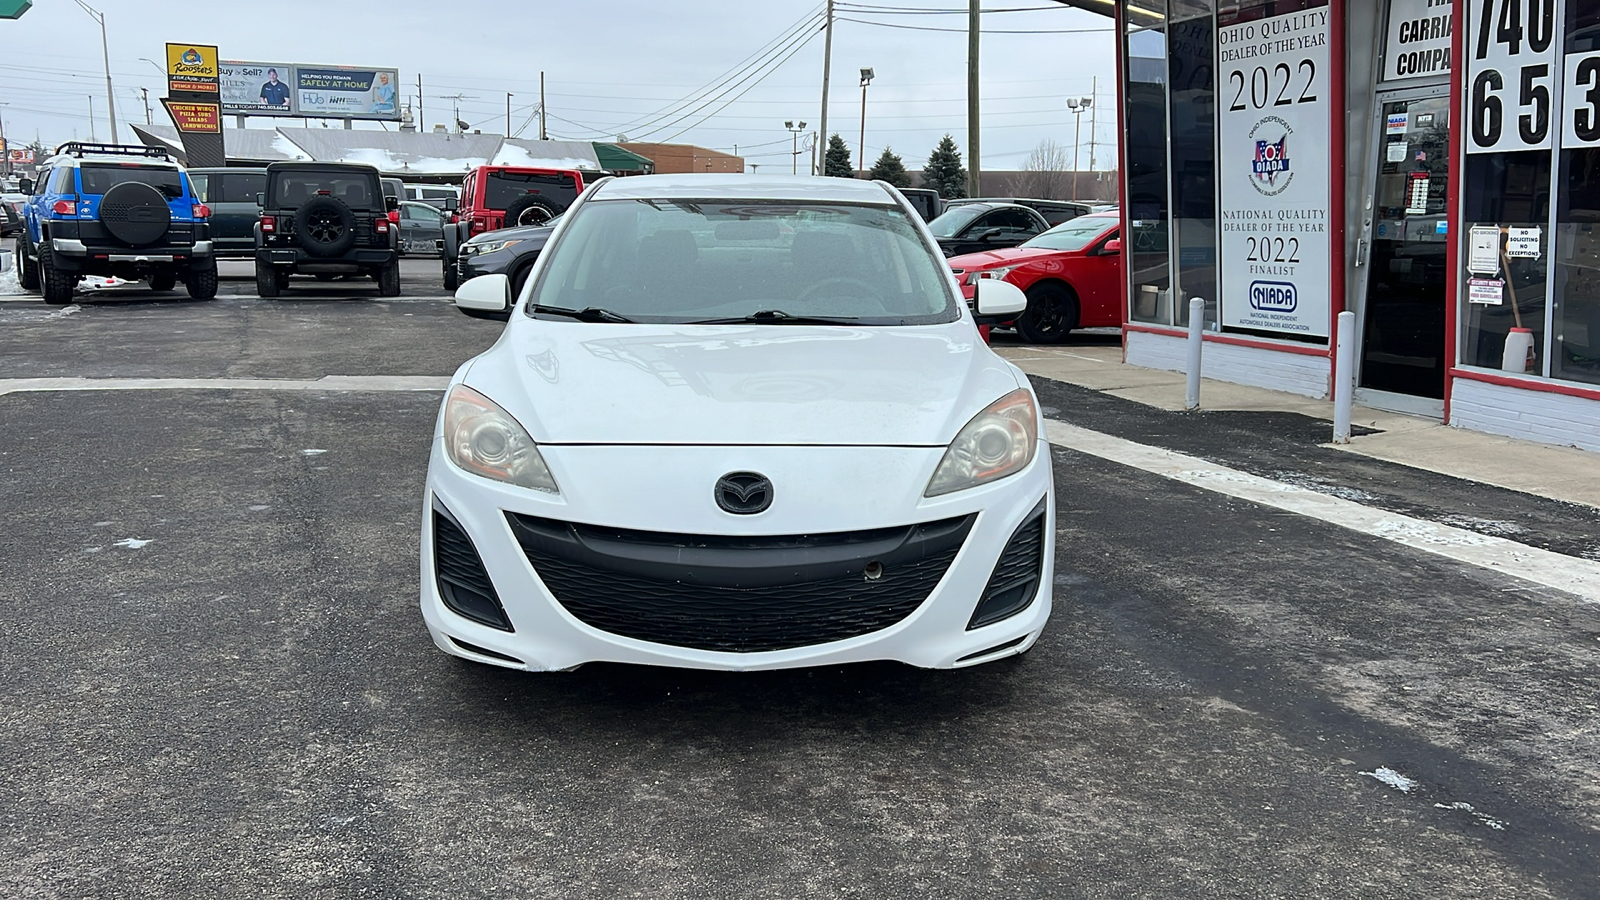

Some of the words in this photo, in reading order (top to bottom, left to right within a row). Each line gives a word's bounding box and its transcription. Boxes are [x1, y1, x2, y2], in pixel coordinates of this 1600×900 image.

[1220, 25, 1255, 45] OHIO
[1261, 10, 1328, 39] QUALITY
[1475, 0, 1554, 60] 740
[1221, 45, 1258, 62] DEALER
[1259, 42, 1273, 56] OF
[1274, 38, 1295, 53] THE
[1297, 32, 1326, 49] YEAR
[173, 62, 213, 75] Roosters
[1396, 47, 1451, 76] COMPA
[218, 67, 234, 77] Buy
[242, 68, 263, 76] Sell?
[300, 79, 331, 87] SAFELY
[1229, 58, 1317, 112] 2022
[1248, 122, 1260, 139] OHIO
[1259, 115, 1294, 135] INDEPENDENT
[1256, 160, 1284, 172] OIADA
[1222, 210, 1274, 220] NATIONAL
[1277, 209, 1326, 221] QUALITY
[1224, 223, 1258, 232] DEALER
[1260, 223, 1273, 232] OF
[1276, 223, 1295, 232] THE
[1298, 223, 1324, 233] YEAR
[1246, 236, 1300, 263] 2022
[1249, 265, 1295, 276] FINALIST
[1253, 287, 1293, 307] NIADA
[1270, 314, 1298, 322] INDEPENDENT
